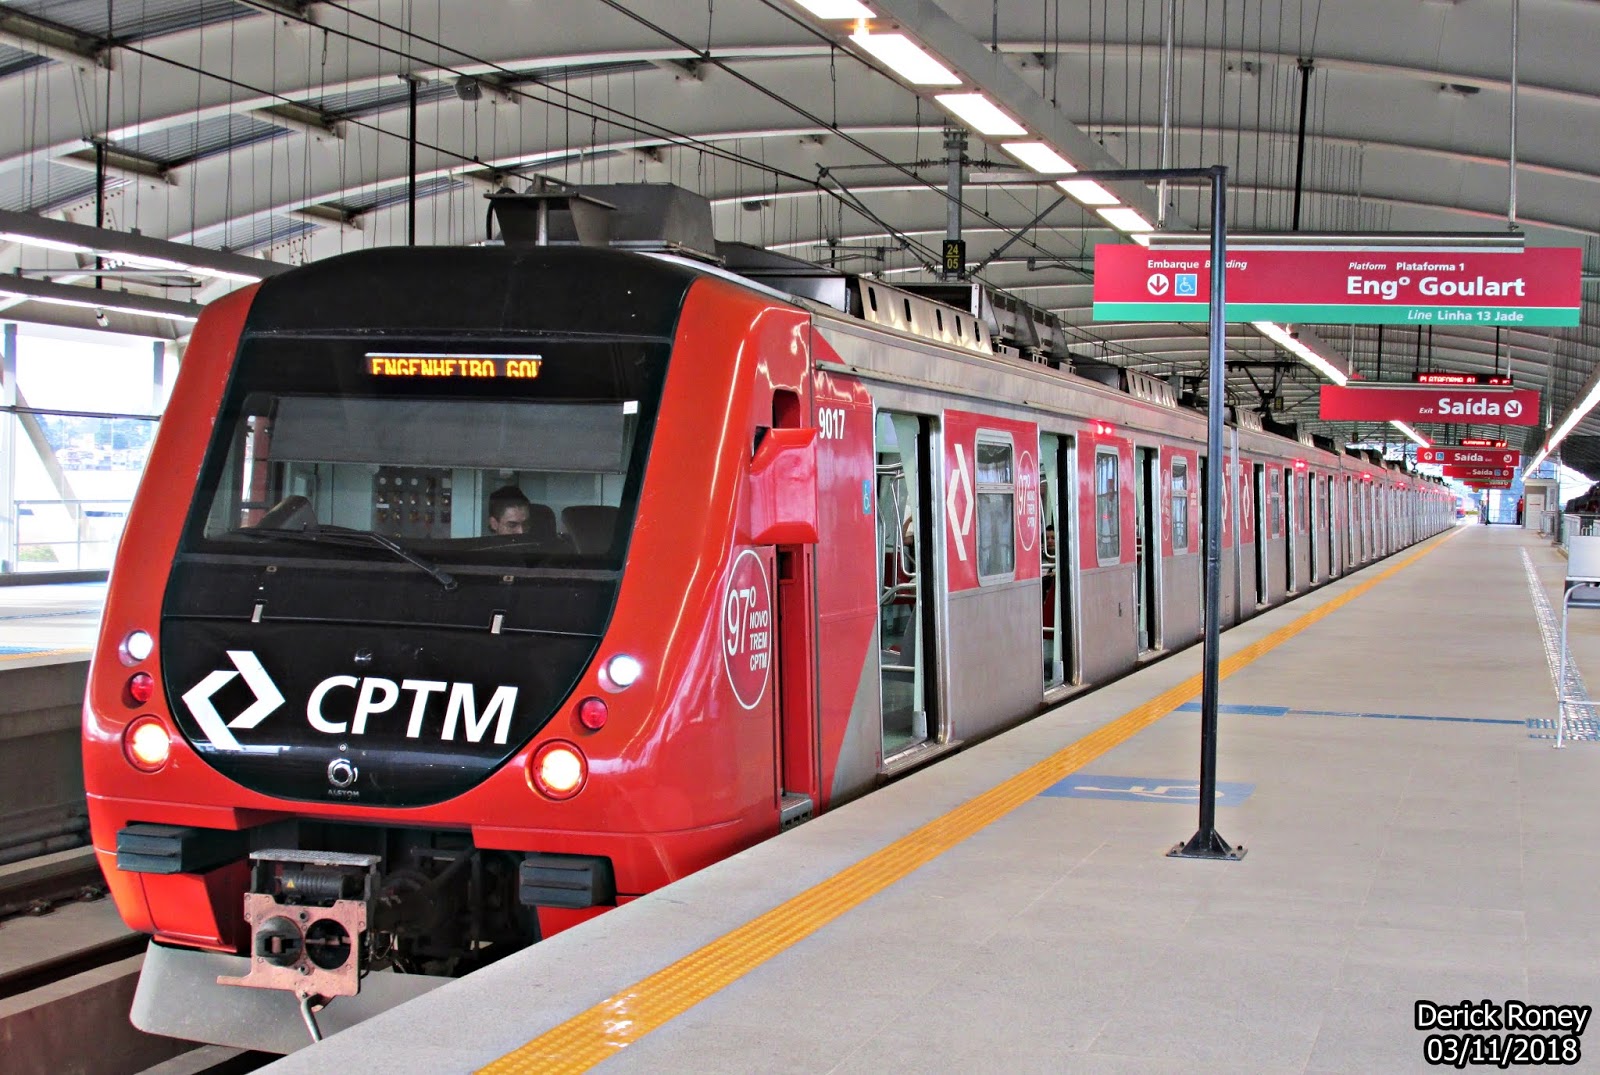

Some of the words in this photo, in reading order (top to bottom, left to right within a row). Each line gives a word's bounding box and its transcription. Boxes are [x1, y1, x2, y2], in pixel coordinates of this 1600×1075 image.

[947, 243, 959, 255] 24
[947, 258, 959, 269] 05
[1147, 259, 1199, 270] Embarque
[1205, 259, 1248, 271] Bding
[1348, 262, 1387, 271] Platform
[1396, 262, 1456, 271] Plataforma
[1459, 263, 1465, 271] 1
[1418, 276, 1526, 297] Goulart
[1407, 310, 1433, 320] Line
[1437, 311, 1473, 321] Linha
[1477, 311, 1491, 321] 13
[1494, 311, 1524, 322] Jade
[1438, 397, 1500, 416] Saída
[818, 407, 846, 440] 9017
[1454, 452, 1484, 462] Saída
[750, 609, 768, 630] NOVO
[750, 631, 768, 651] TREM
[750, 652, 768, 671] CPTM
[306, 674, 519, 745] CPTM
